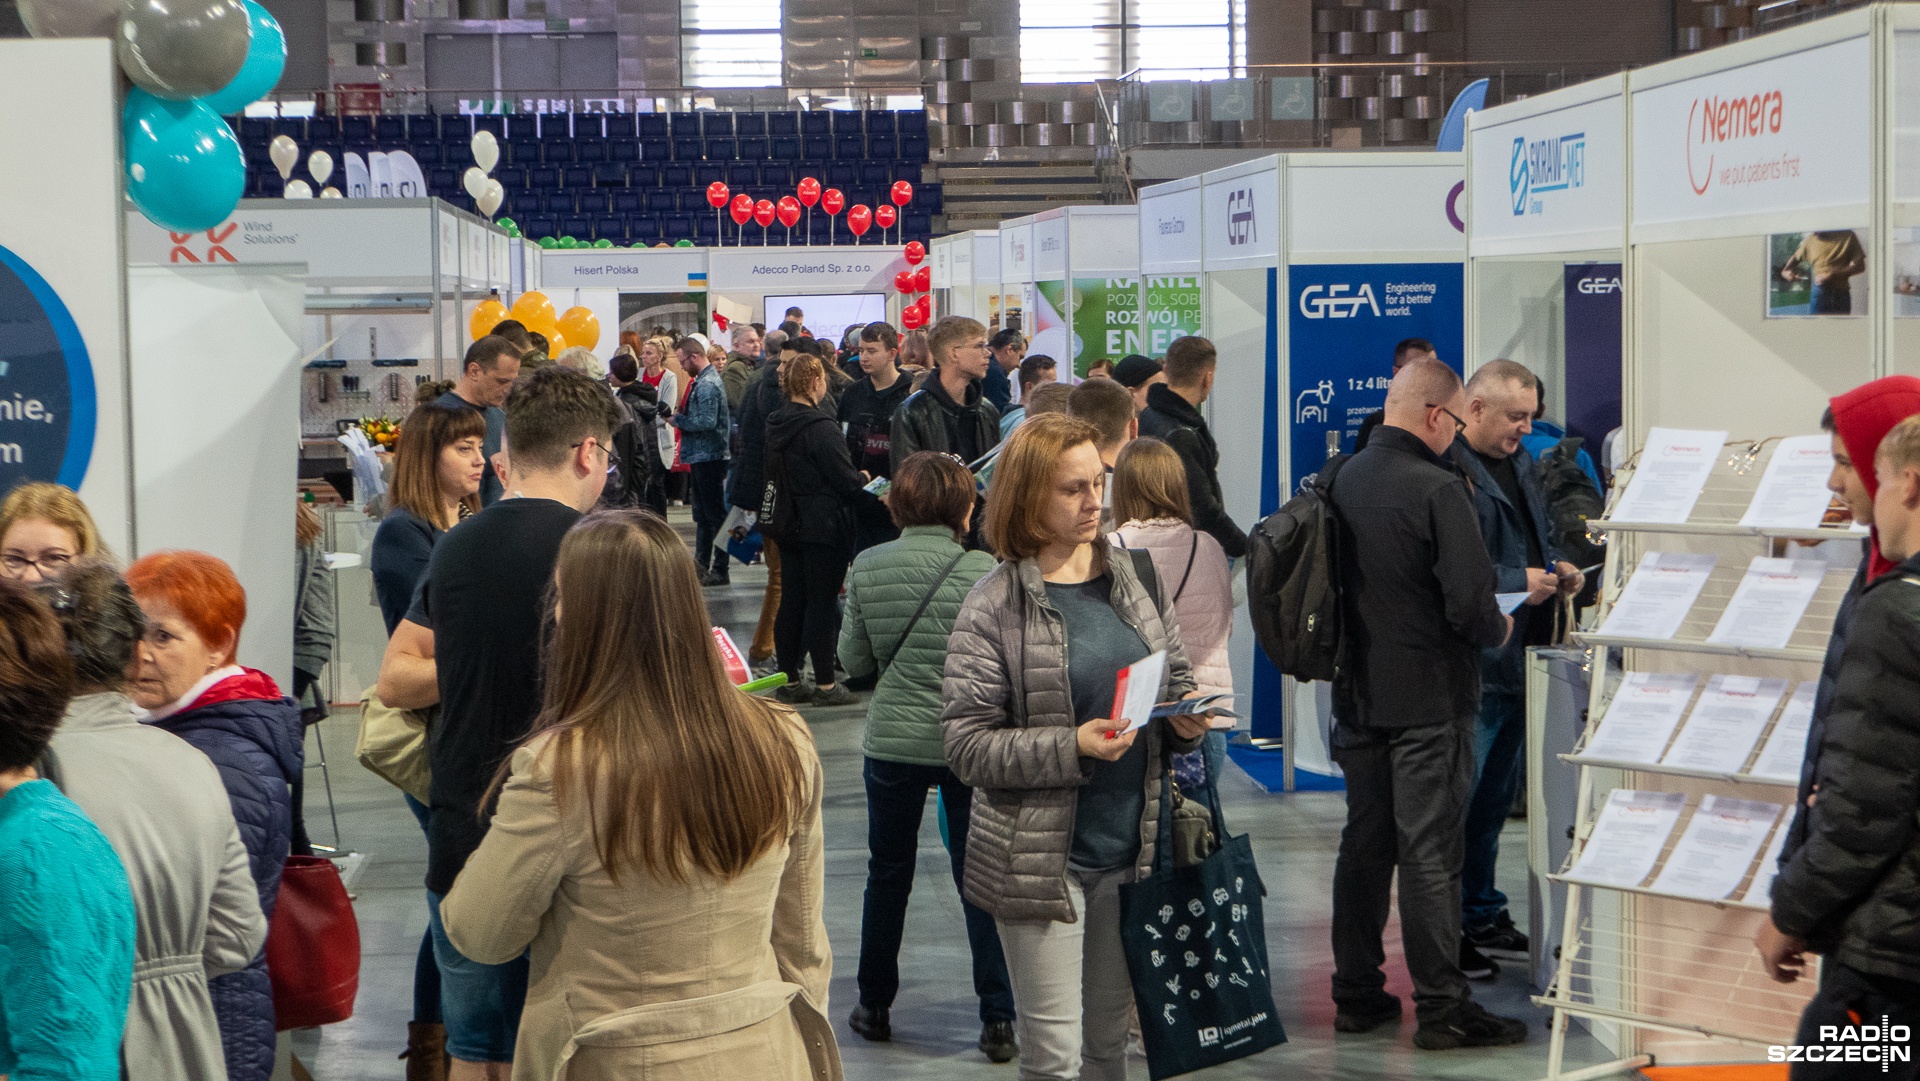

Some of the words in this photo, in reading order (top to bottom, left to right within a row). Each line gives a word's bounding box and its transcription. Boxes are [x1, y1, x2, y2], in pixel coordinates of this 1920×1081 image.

[1701, 89, 1783, 144] Nemera
[1227, 187, 1258, 246] GEA
[243, 221, 272, 232] Wind
[574, 265, 603, 275] Hisert
[605, 265, 639, 275] Polska
[752, 265, 789, 274] Adecco
[791, 264, 825, 274] Poland
[828, 263, 844, 275] Sp.
[855, 264, 873, 272] o.o.
[1385, 282, 1437, 295] Engineering
[1578, 277, 1623, 294] GEA
[1300, 283, 1381, 319] GEA
[1385, 294, 1398, 305] for
[1399, 296, 1405, 304] a
[1406, 294, 1433, 304] better
[1385, 306, 1412, 316] world.
[1347, 378, 1354, 391] 1
[1355, 380, 1364, 391] z
[1365, 377, 1375, 390] 4
